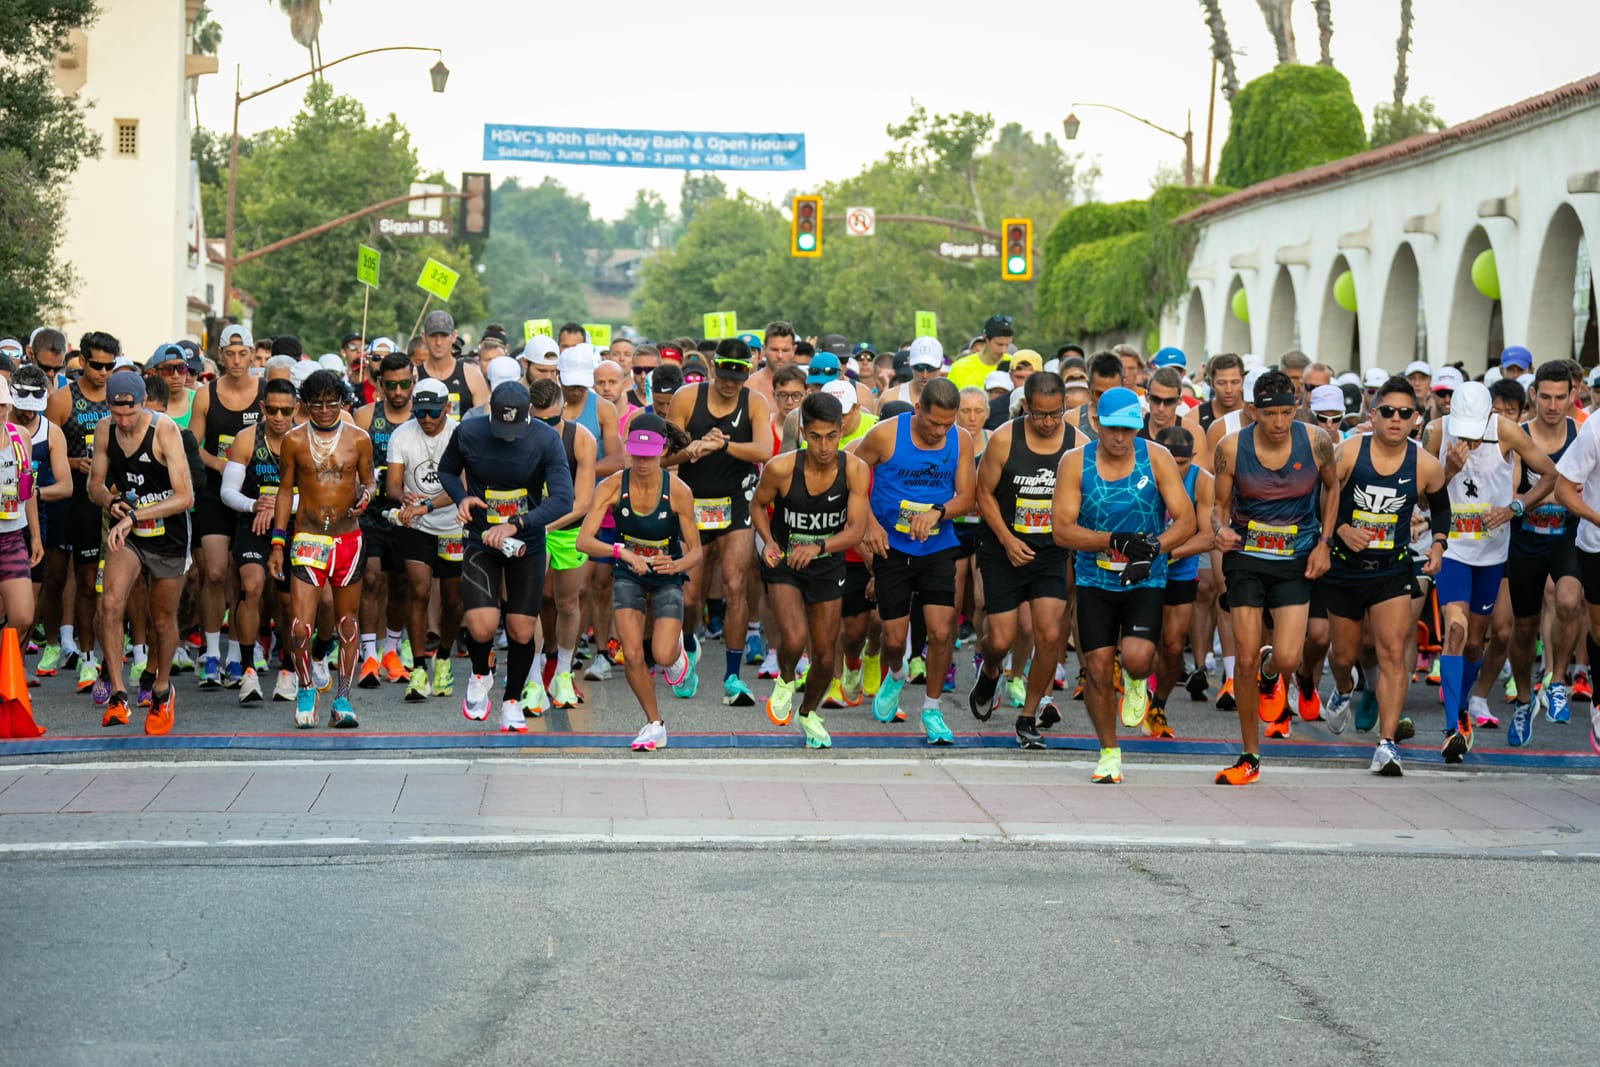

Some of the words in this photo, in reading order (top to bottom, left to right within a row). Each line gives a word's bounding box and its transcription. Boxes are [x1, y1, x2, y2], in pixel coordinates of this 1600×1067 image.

[491, 130, 544, 144] HSVC's
[546, 131, 582, 145] 90th
[585, 132, 648, 150] Birthday
[652, 135, 690, 148] Bash
[693, 136, 703, 150] &
[707, 137, 748, 153] Open
[751, 138, 797, 151] House
[557, 148, 587, 160] June
[663, 154, 685, 165] pm
[380, 219, 424, 235] Signal
[428, 219, 449, 234] St.
[940, 242, 979, 258] Signal
[981, 243, 1000, 257] St.
[430, 268, 449, 285] 3:25
[243, 412, 259, 420] DMT
[784, 507, 847, 530] MEXICO
